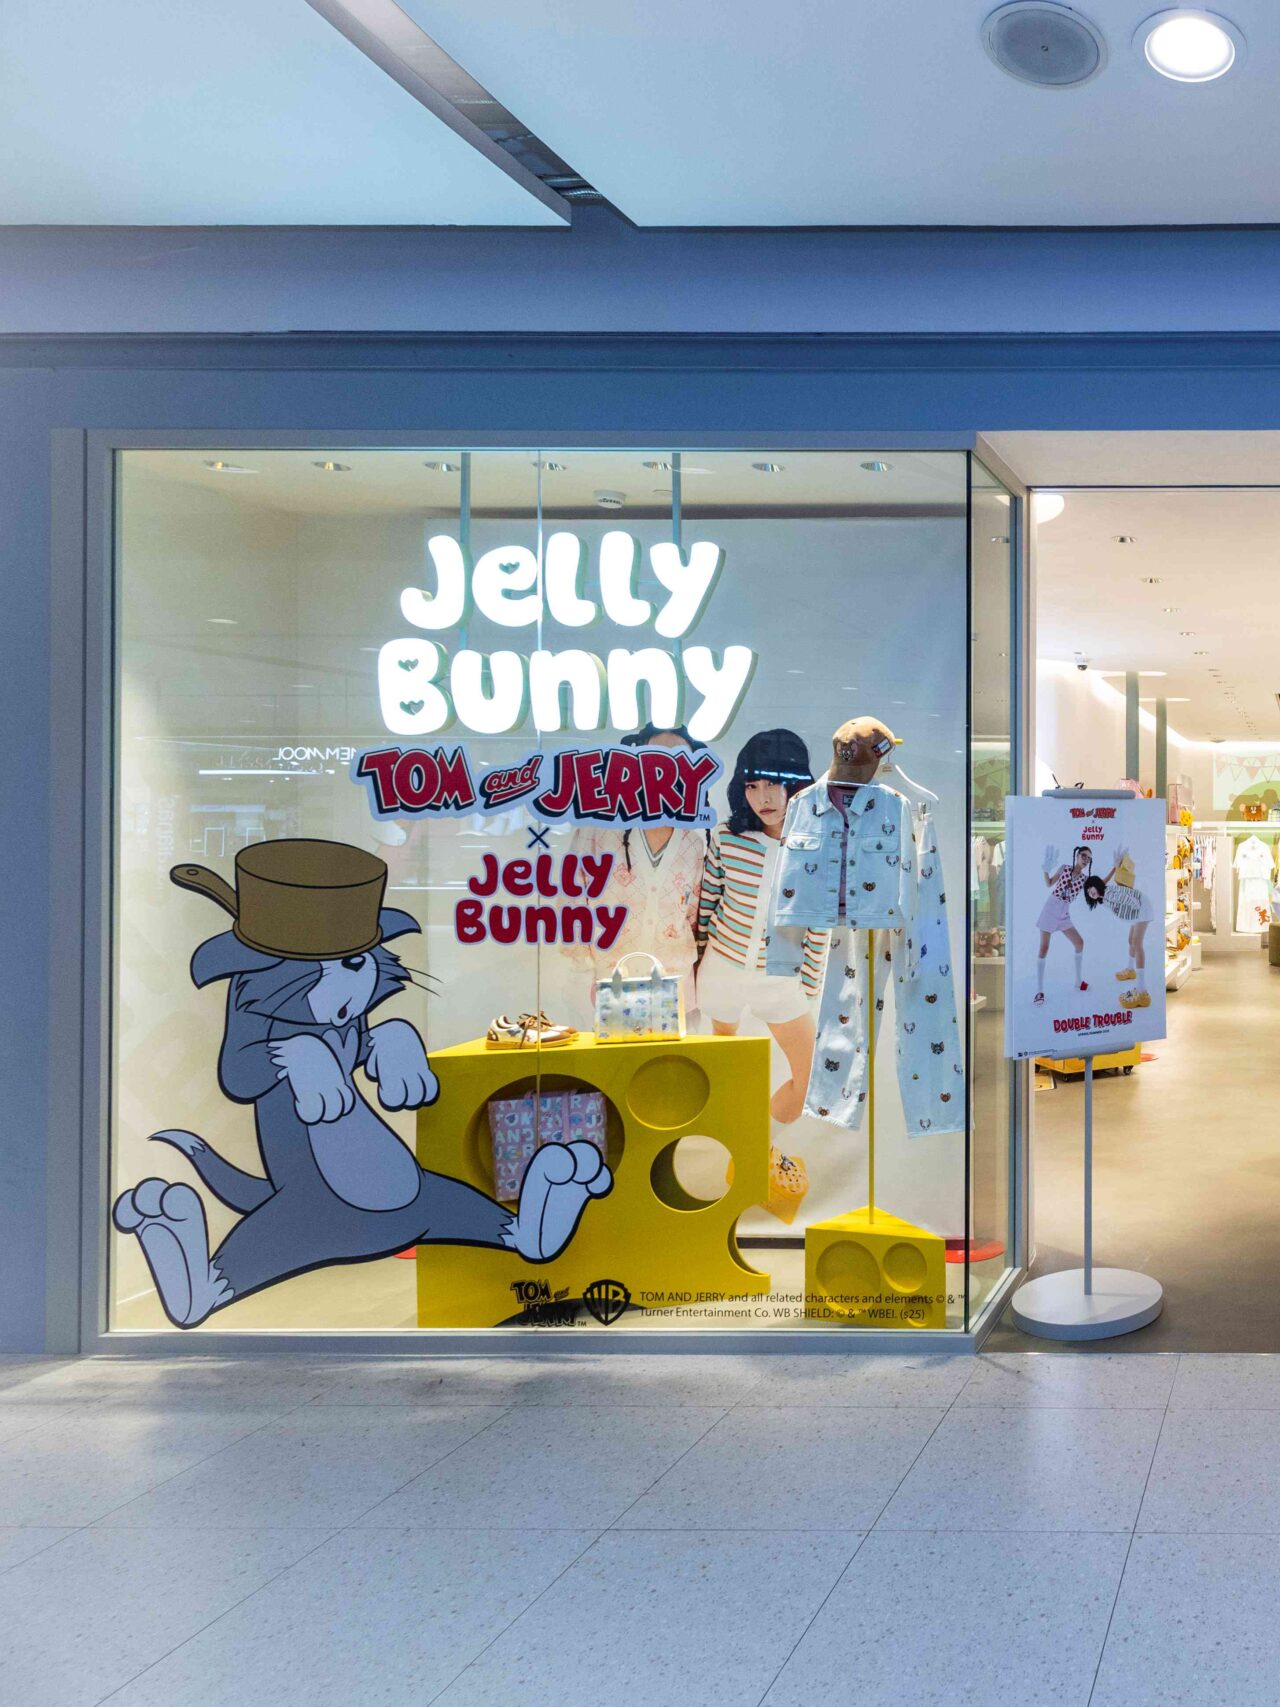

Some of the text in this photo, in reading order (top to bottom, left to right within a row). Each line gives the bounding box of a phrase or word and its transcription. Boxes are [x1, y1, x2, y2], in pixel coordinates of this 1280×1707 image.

[400, 531, 722, 638] Jelly
[378, 638, 756, 742] Bunny
[361, 747, 477, 814] TOM
[480, 756, 543, 805] and
[533, 749, 719, 823] JERRY
[467, 853, 615, 898] Jelly
[455, 899, 629, 950] Bunny
[1053, 1016, 1091, 1033] DOUBLE
[1092, 1010, 1133, 1029] TROUBLE
[510, 1278, 551, 1304] TOM
[640, 1291, 665, 1302] TOM
[668, 1291, 692, 1302] AND
[695, 1291, 726, 1303] JERRY
[728, 1292, 749, 1303] and
[752, 1292, 763, 1303] all
[766, 1293, 802, 1303] related
[805, 1293, 859, 1304] characters
[862, 1293, 882, 1304] and
[885, 1293, 933, 1304] elements
[640, 1308, 674, 1317] Turner
[676, 1308, 751, 1317] Entertainment
[754, 1308, 771, 1318] Co.
[773, 1308, 791, 1317] WB
[793, 1308, 834, 1318] SHIELD:
[868, 1309, 897, 1318] WBEI.
[900, 1309, 925, 1320] (s25)
